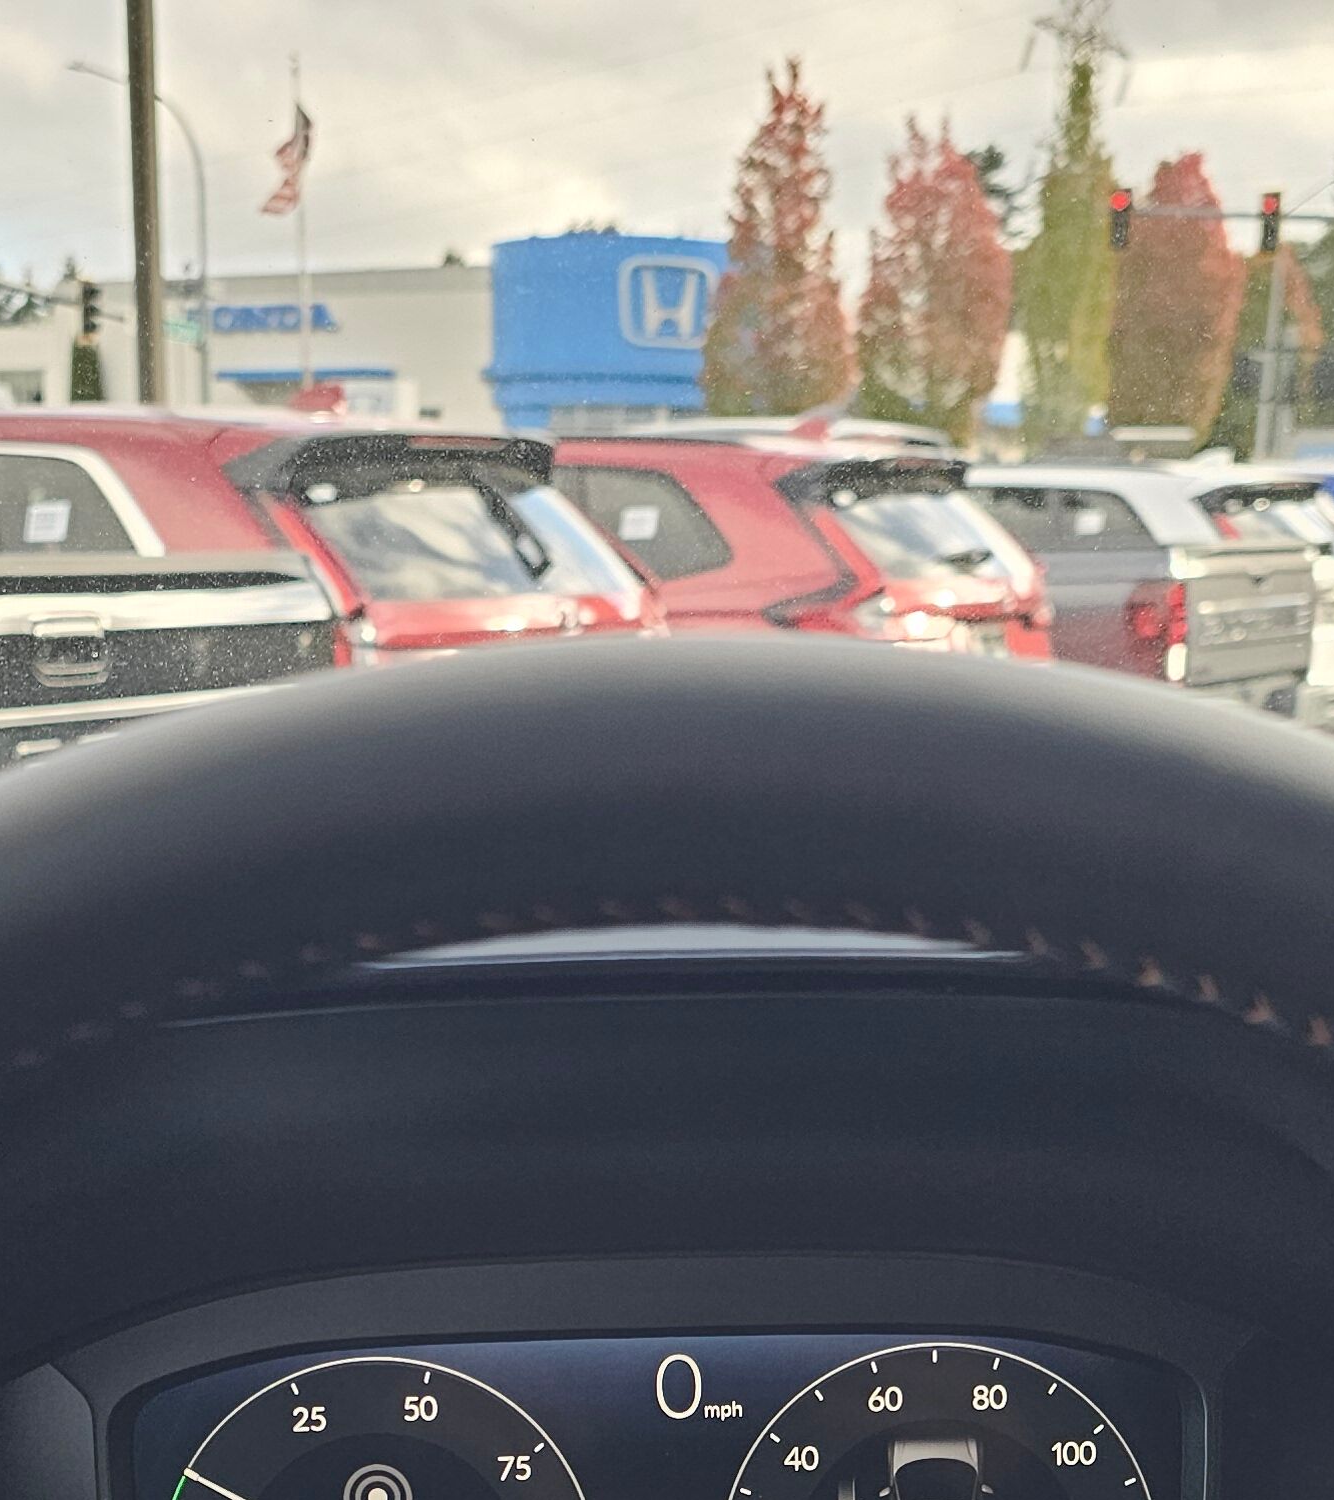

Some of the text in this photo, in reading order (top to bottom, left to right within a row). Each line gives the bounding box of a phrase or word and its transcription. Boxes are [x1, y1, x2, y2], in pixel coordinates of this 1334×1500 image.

[655, 1353, 743, 1421] 0 mph
[867, 1386, 903, 1412] 60
[972, 1384, 1008, 1411] 80
[292, 1406, 327, 1433] 25
[403, 1396, 438, 1422] 50
[783, 1445, 820, 1472] 40
[1051, 1440, 1097, 1467] 100
[497, 1455, 532, 1481] 75
